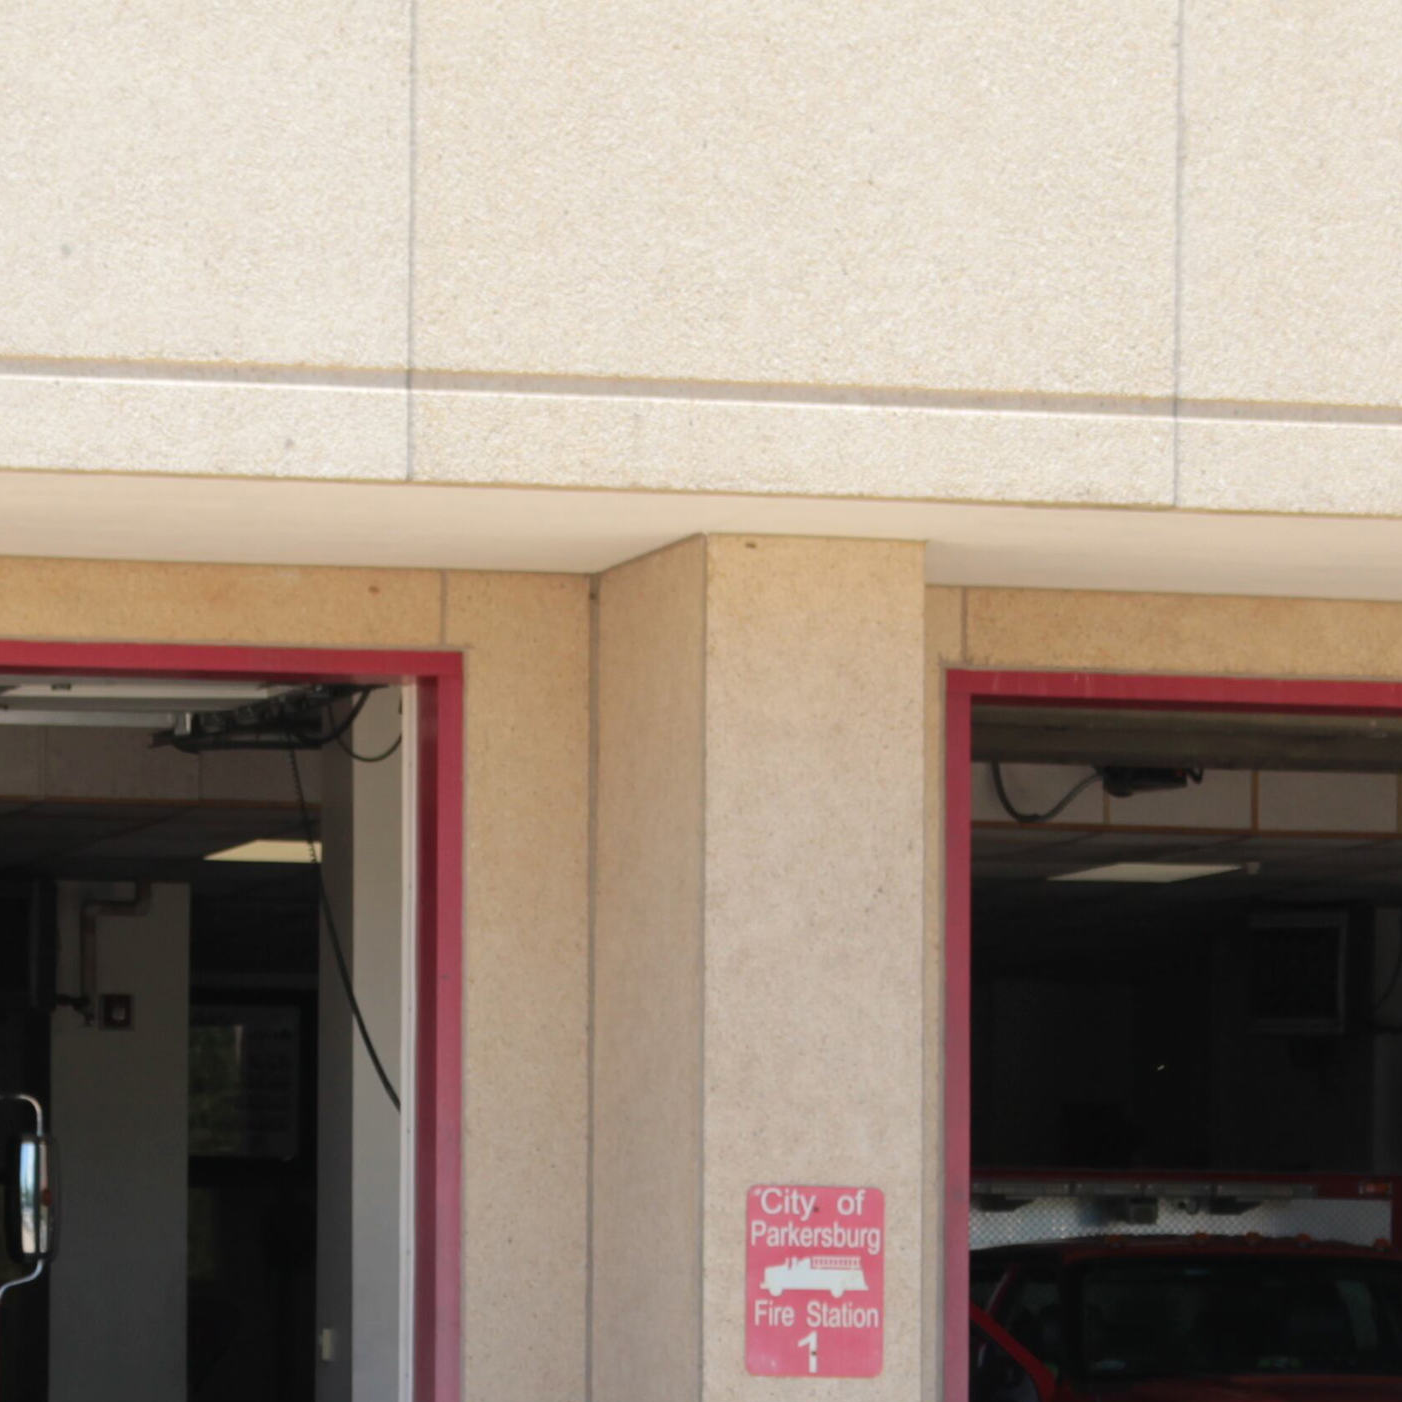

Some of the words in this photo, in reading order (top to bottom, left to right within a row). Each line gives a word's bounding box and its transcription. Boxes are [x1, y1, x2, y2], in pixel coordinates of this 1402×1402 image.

[760, 1187, 816, 1221] City
[836, 1189, 866, 1216] of
[750, 1220, 881, 1255] Parkersburg
[754, 1299, 795, 1327] Fire
[806, 1300, 879, 1329] Station
[797, 1330, 818, 1374] 1
